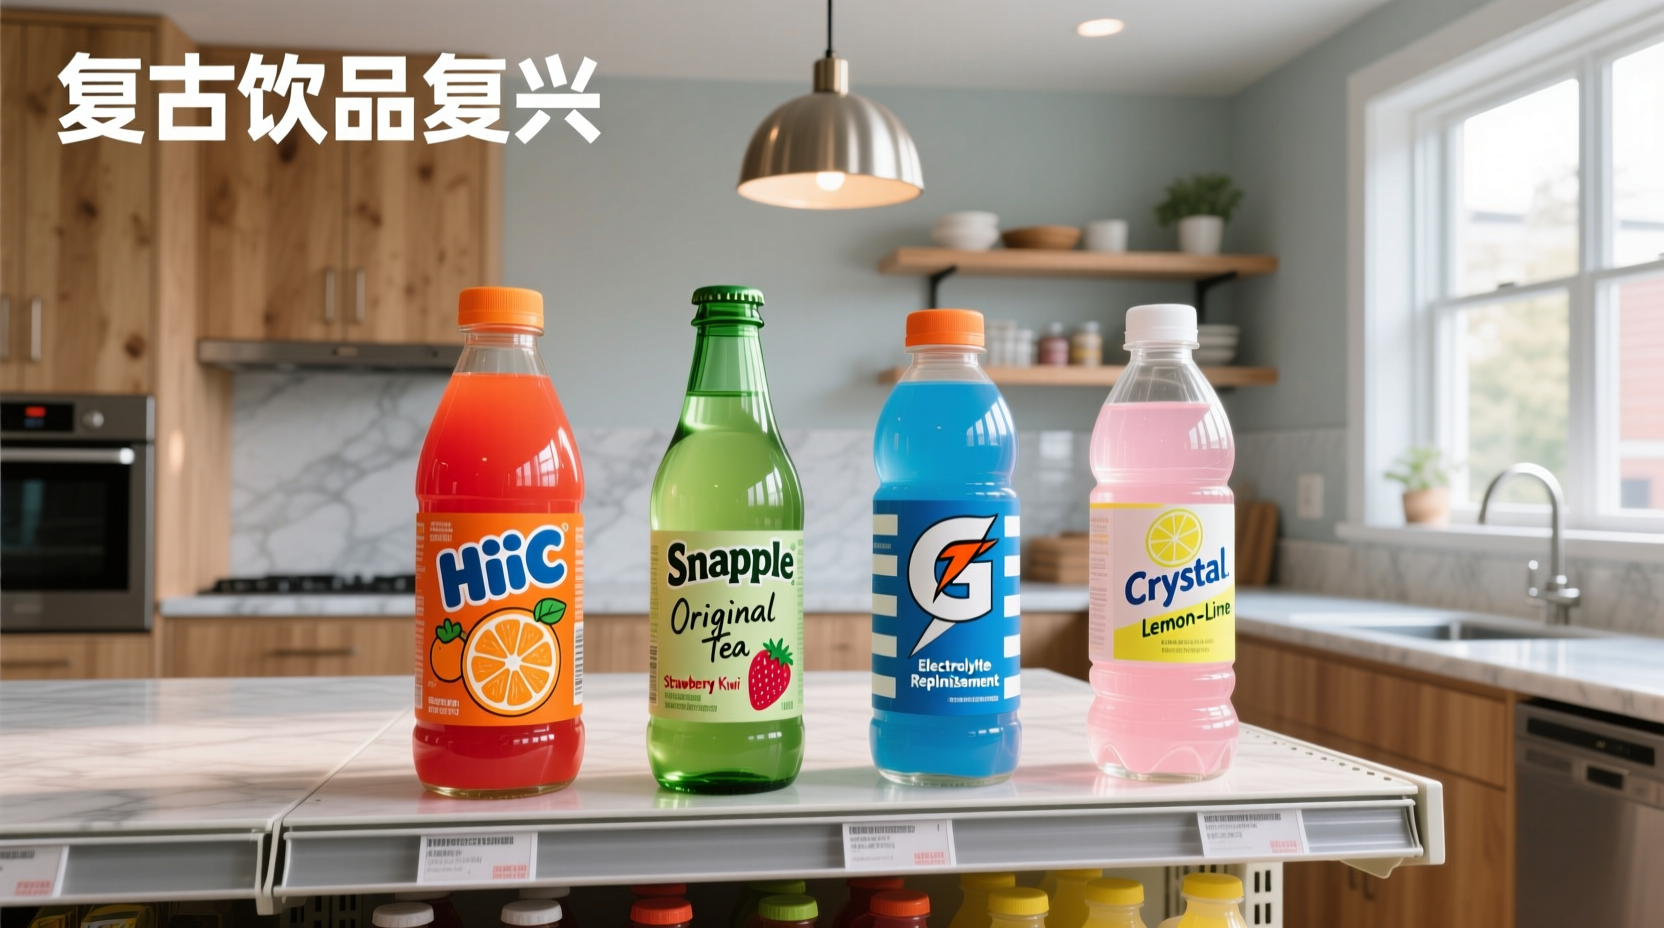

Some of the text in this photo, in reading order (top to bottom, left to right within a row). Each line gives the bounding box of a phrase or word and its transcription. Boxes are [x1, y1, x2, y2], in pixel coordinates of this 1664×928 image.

[667, 540, 794, 587] Snapple
[1125, 547, 1229, 607] Crystal
[671, 591, 775, 642] Original
[702, 632, 750, 663] Tea
